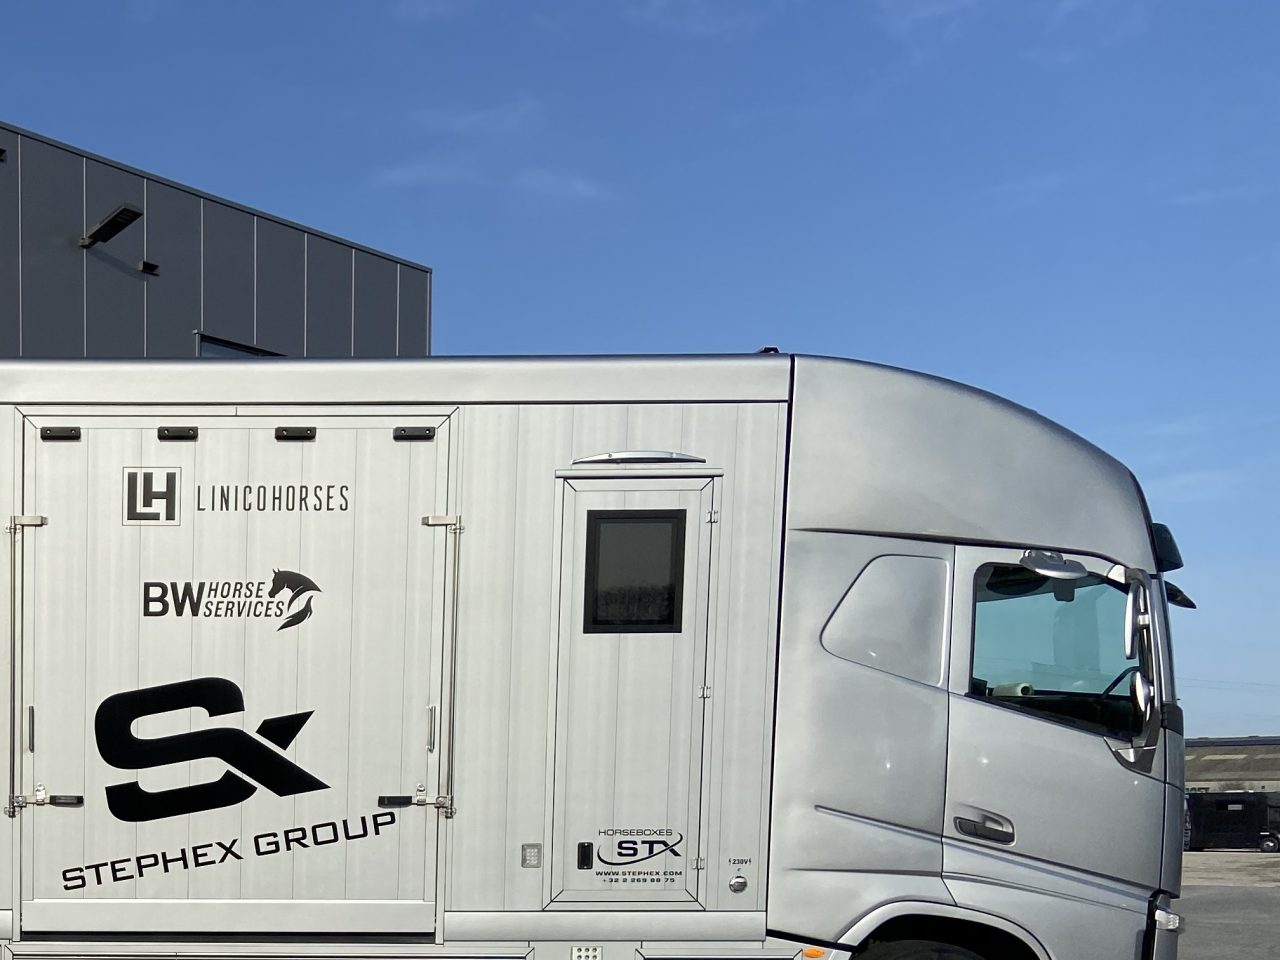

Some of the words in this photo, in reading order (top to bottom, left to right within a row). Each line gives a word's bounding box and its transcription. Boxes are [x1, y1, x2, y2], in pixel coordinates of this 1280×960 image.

[127, 472, 176, 520] LH
[197, 485, 349, 511] LINICOHORSES
[143, 582, 205, 617] BW
[207, 582, 265, 598] HORSE
[203, 601, 284, 617] SERVICES
[62, 838, 244, 891] STEPHEX
[253, 811, 396, 856] GROUP
[617, 840, 682, 857] STX
